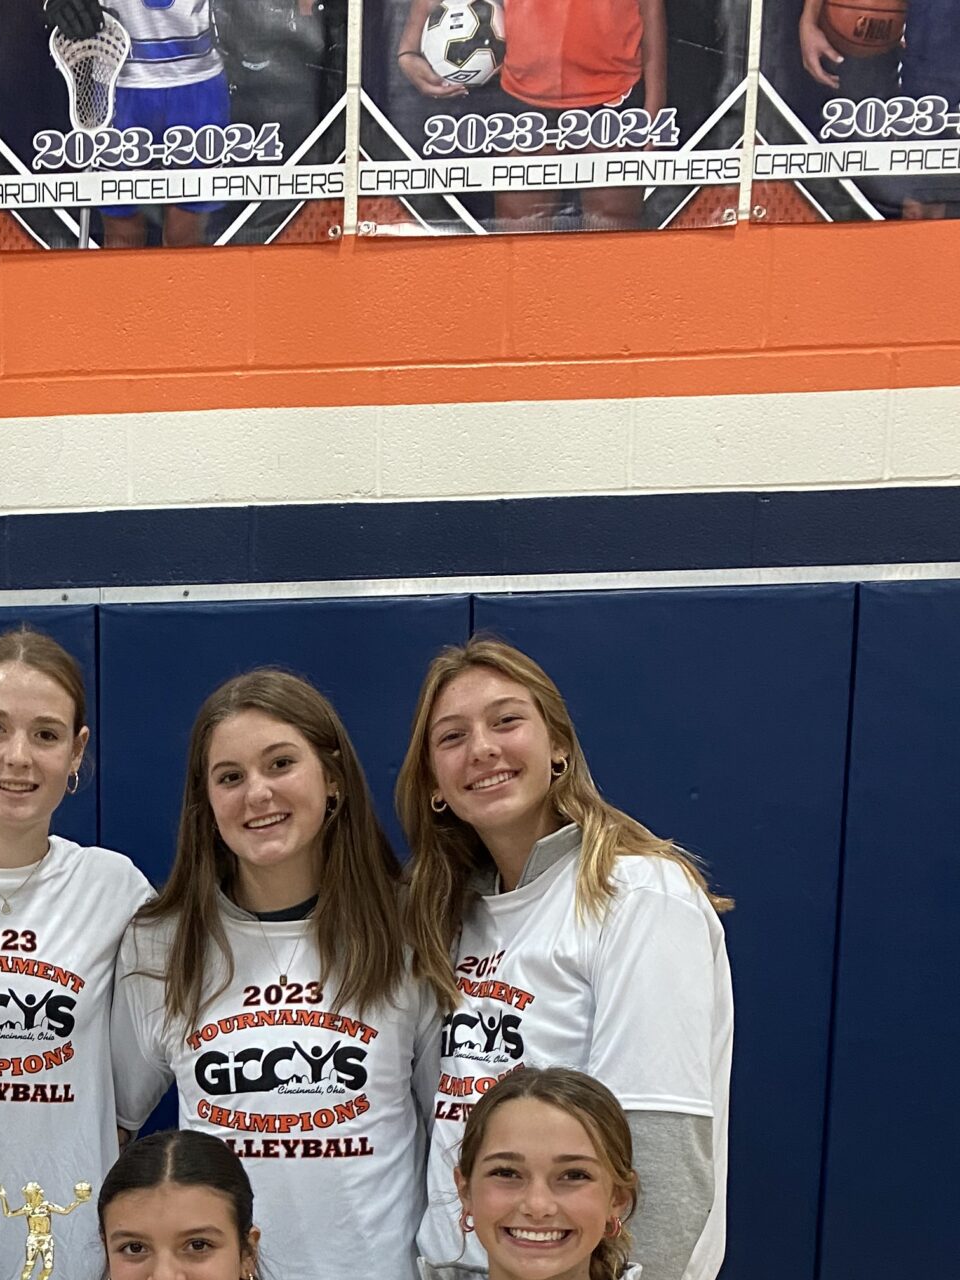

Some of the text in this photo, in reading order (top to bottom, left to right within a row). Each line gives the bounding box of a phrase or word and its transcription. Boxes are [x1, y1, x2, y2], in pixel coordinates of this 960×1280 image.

[423, 108, 680, 156] 2023-2024
[821, 95, 960, 139] 2023-
[32, 123, 283, 170] 2023-2024
[755, 148, 960, 175] CARDINAL PACE
[101, 177, 201, 201] PACELLI
[212, 172, 344, 197] PANTHERS
[360, 157, 740, 190] CARDINAL PACELLI PANTHERS
[243, 982, 323, 1006] 2023
[37, 1031, 54, 1041] Ohio
[186, 1009, 378, 1051] TOURNAMENT
[195, 1040, 368, 1095] GCCYS
[326, 1085, 345, 1094] Ohio
[197, 1094, 370, 1133] CHAMPIONS
[226, 1137, 374, 1158] LLEYBALL
